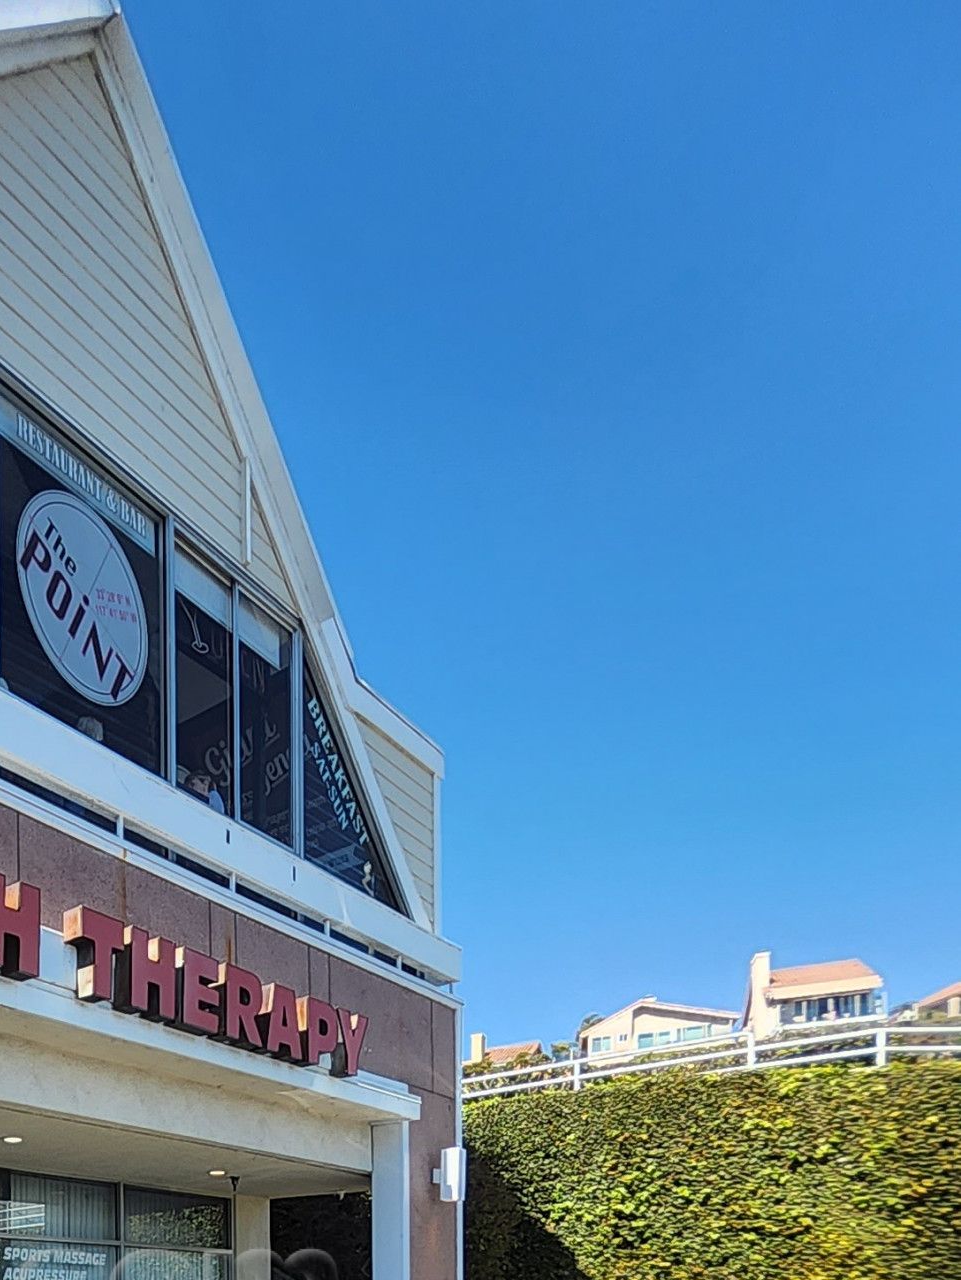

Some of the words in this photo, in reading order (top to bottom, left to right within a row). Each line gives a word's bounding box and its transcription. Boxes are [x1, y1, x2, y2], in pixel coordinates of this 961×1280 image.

[16, 412, 104, 503] RESTAURANT
[105, 488, 119, 516] &
[120, 498, 148, 538] BAR
[44, 516, 77, 577] The
[307, 697, 371, 846] BREAKFAST
[311, 741, 350, 831] SAT-SUN
[66, 903, 369, 1077] THERAPY
[3, 1246, 51, 1263] SPORTS
[54, 1250, 108, 1266] MASSAGE
